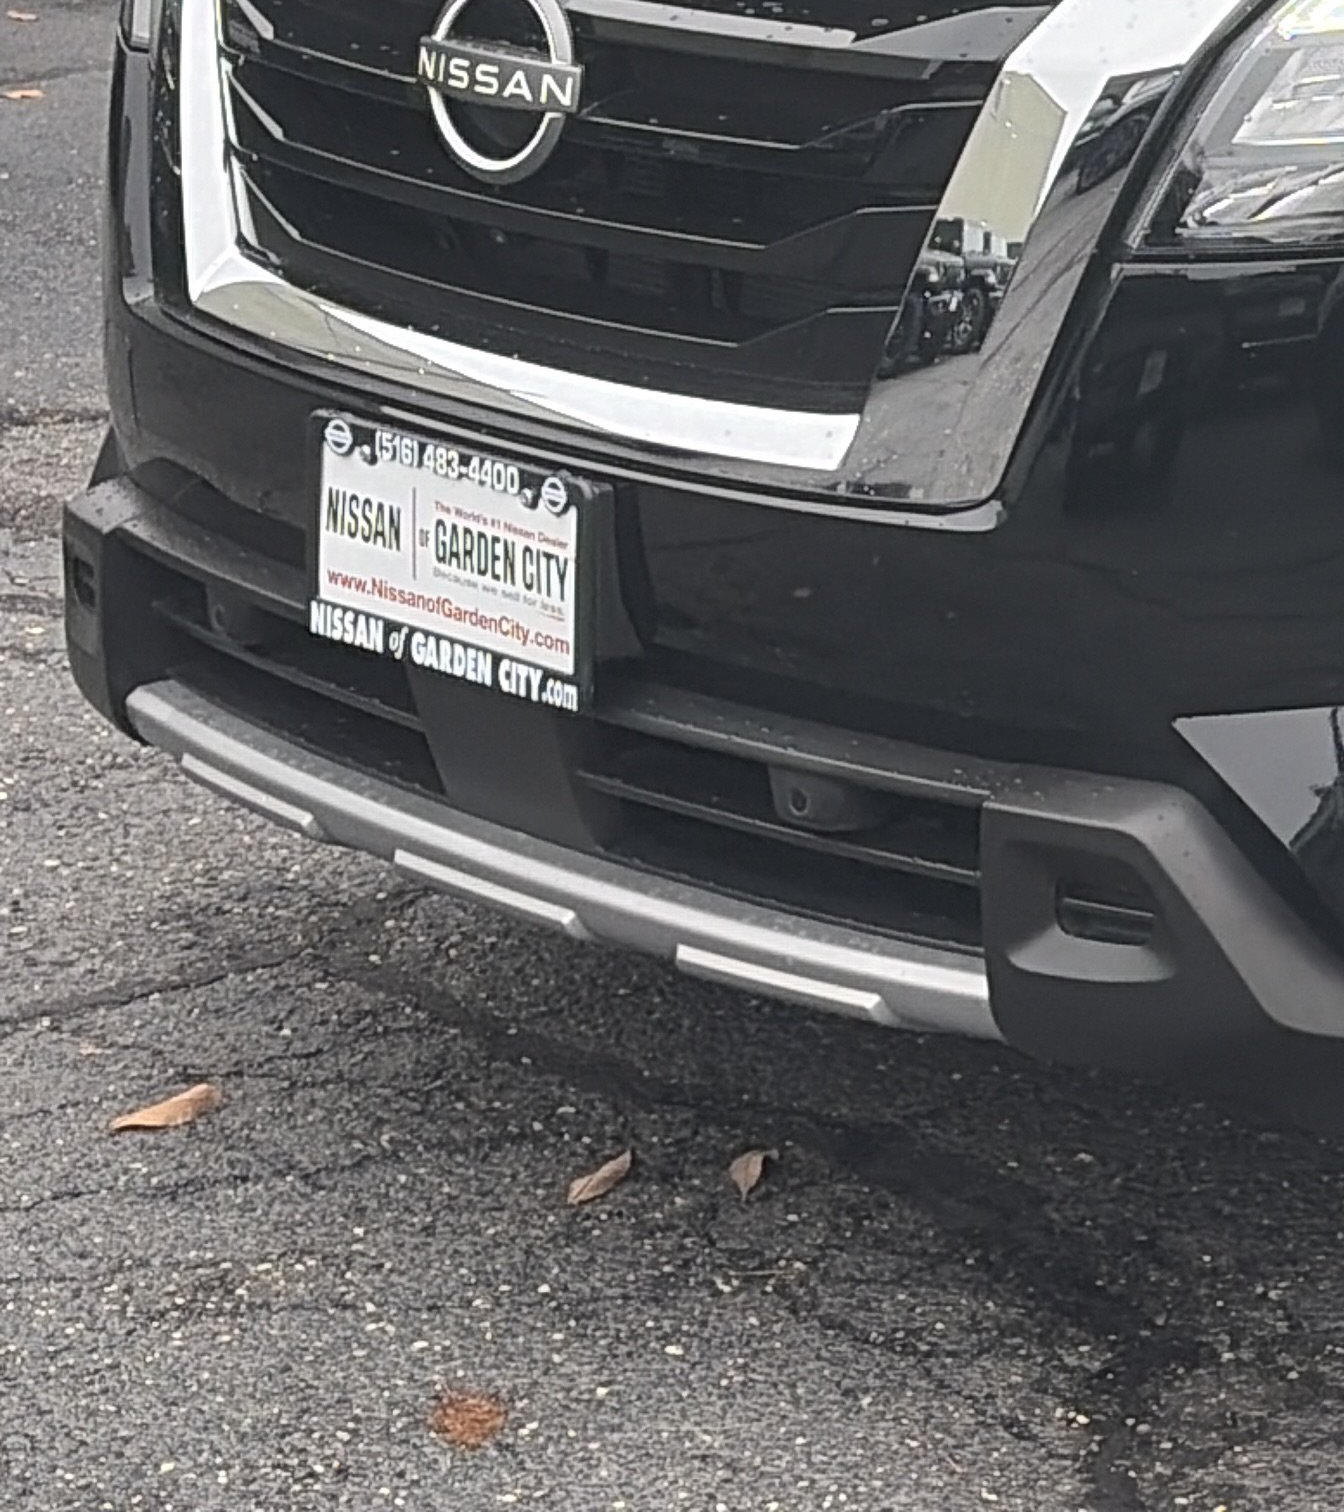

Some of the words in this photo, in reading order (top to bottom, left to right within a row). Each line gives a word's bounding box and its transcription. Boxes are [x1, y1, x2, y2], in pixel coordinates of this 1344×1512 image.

[418, 45, 573, 106] NISSAN
[374, 429, 420, 467] (516)
[423, 443, 520, 495] 483-4400
[325, 486, 401, 551] NISSAN
[418, 528, 430, 548] OF
[435, 518, 516, 587] GARDEN
[522, 545, 568, 602] CITY
[327, 568, 570, 655] www.NissanofGardenCity.com
[310, 601, 384, 654] NISSAN
[389, 625, 409, 660] of
[411, 631, 492, 686] GARDEN
[498, 659, 578, 712] CITY.com
